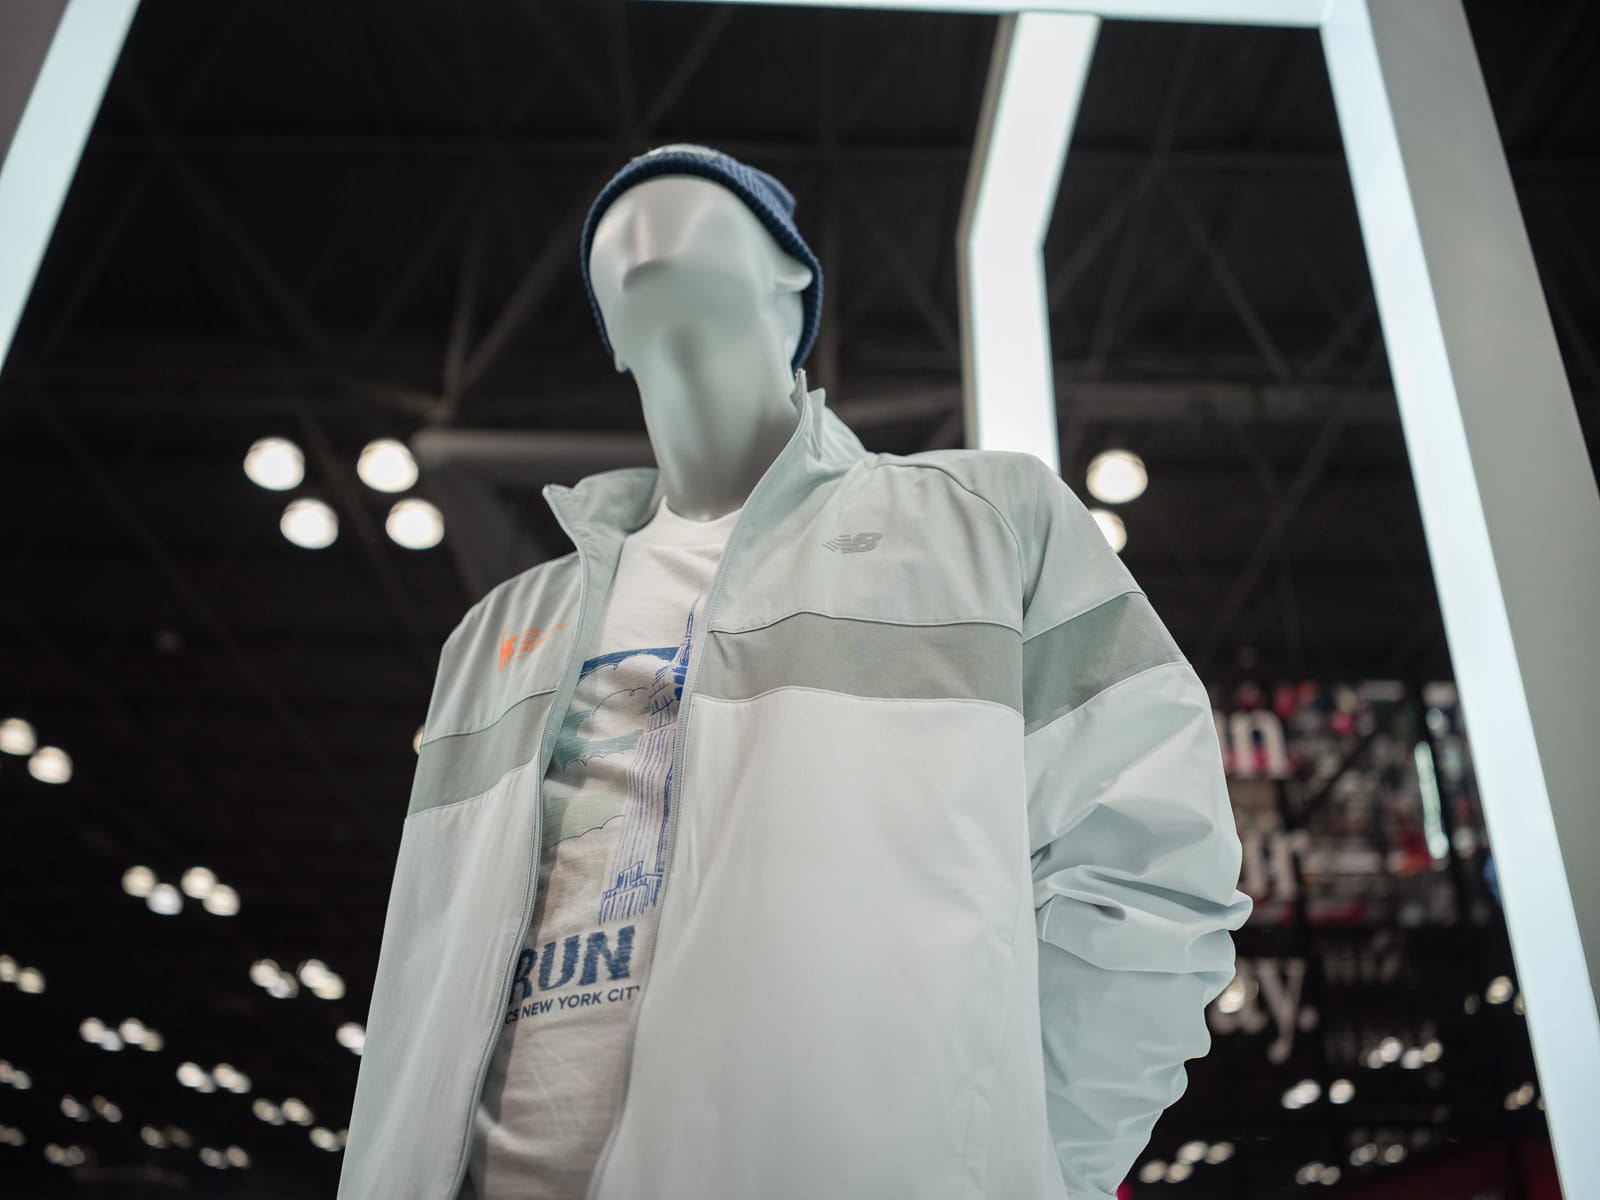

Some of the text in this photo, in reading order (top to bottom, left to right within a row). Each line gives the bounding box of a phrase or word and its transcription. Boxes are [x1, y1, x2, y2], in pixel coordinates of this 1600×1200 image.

[509, 925, 636, 1004] RUN
[521, 998, 554, 1019] NEW
[558, 991, 602, 1010] YORK
[607, 985, 641, 1002] CIT
